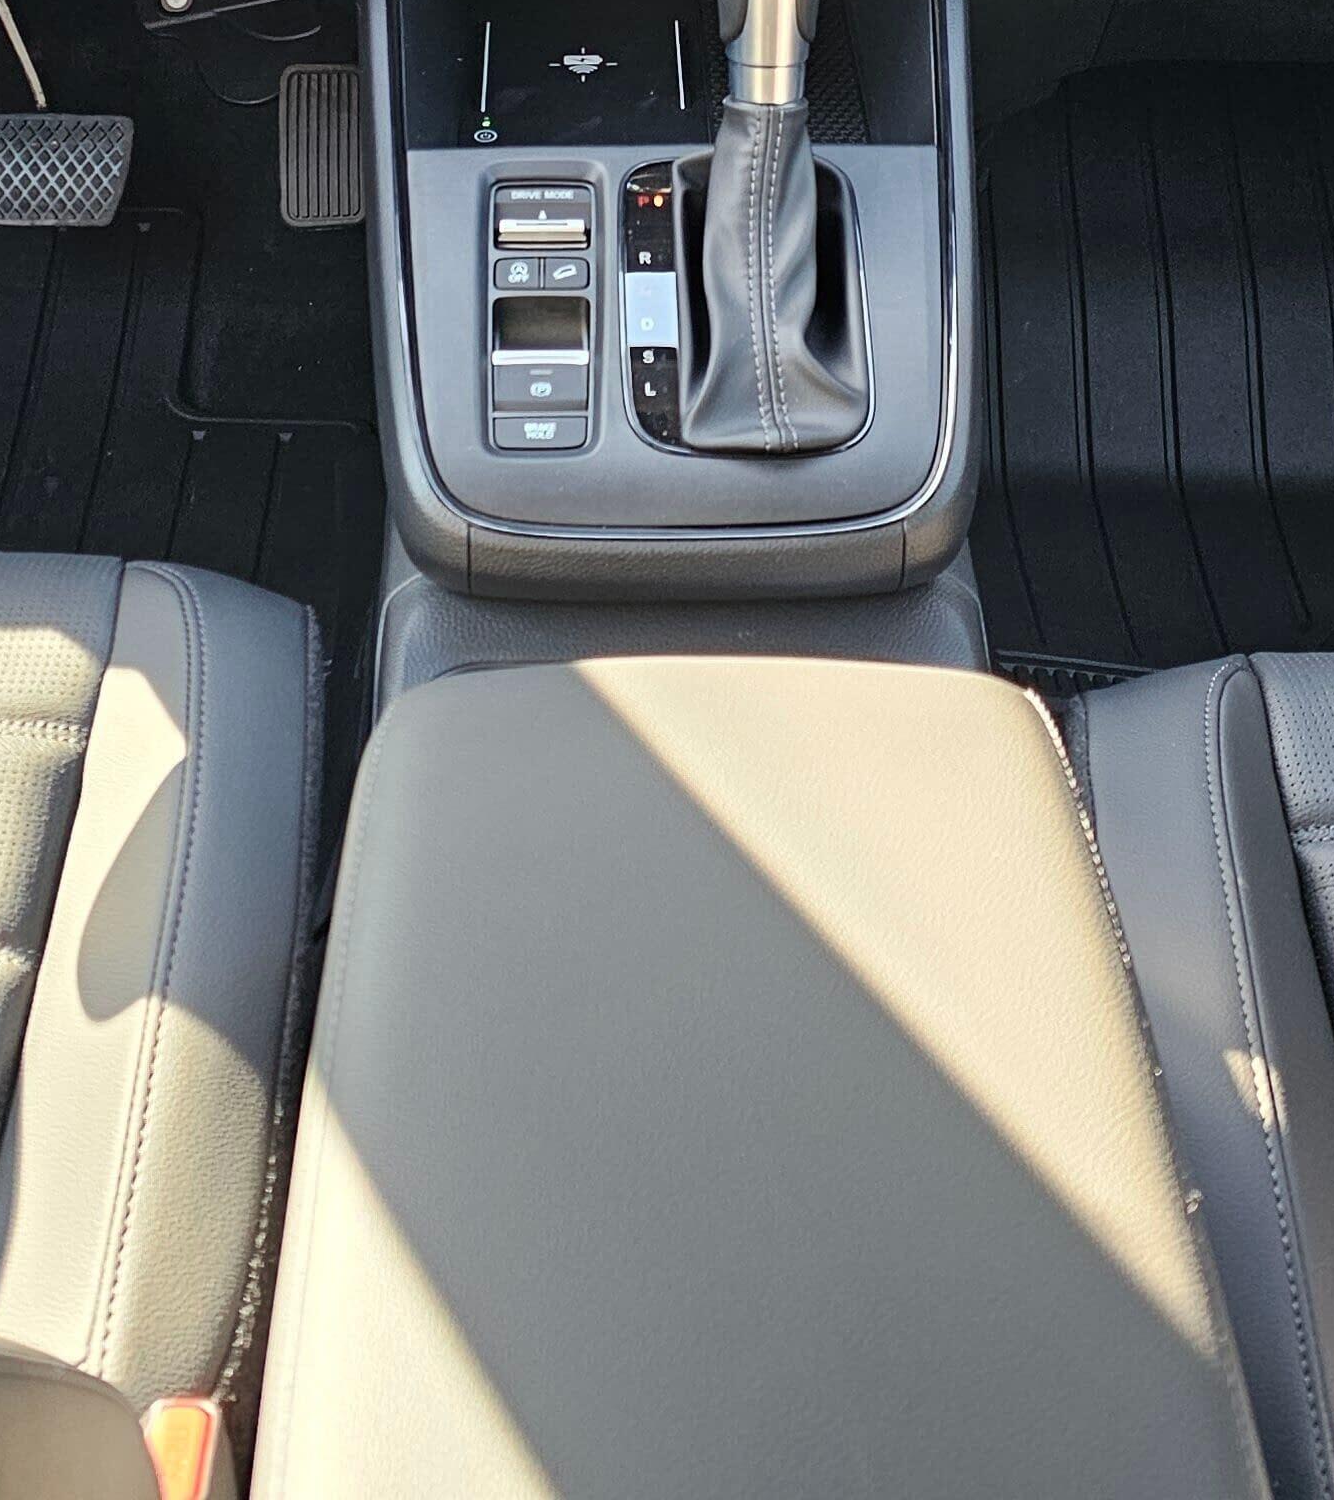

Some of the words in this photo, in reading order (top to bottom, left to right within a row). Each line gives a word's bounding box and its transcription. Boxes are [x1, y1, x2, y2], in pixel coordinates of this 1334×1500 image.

[510, 190, 542, 200] DRIVE
[544, 189, 575, 200] MODE
[638, 251, 652, 265] R
[642, 349, 655, 364] S
[644, 381, 657, 397] L
